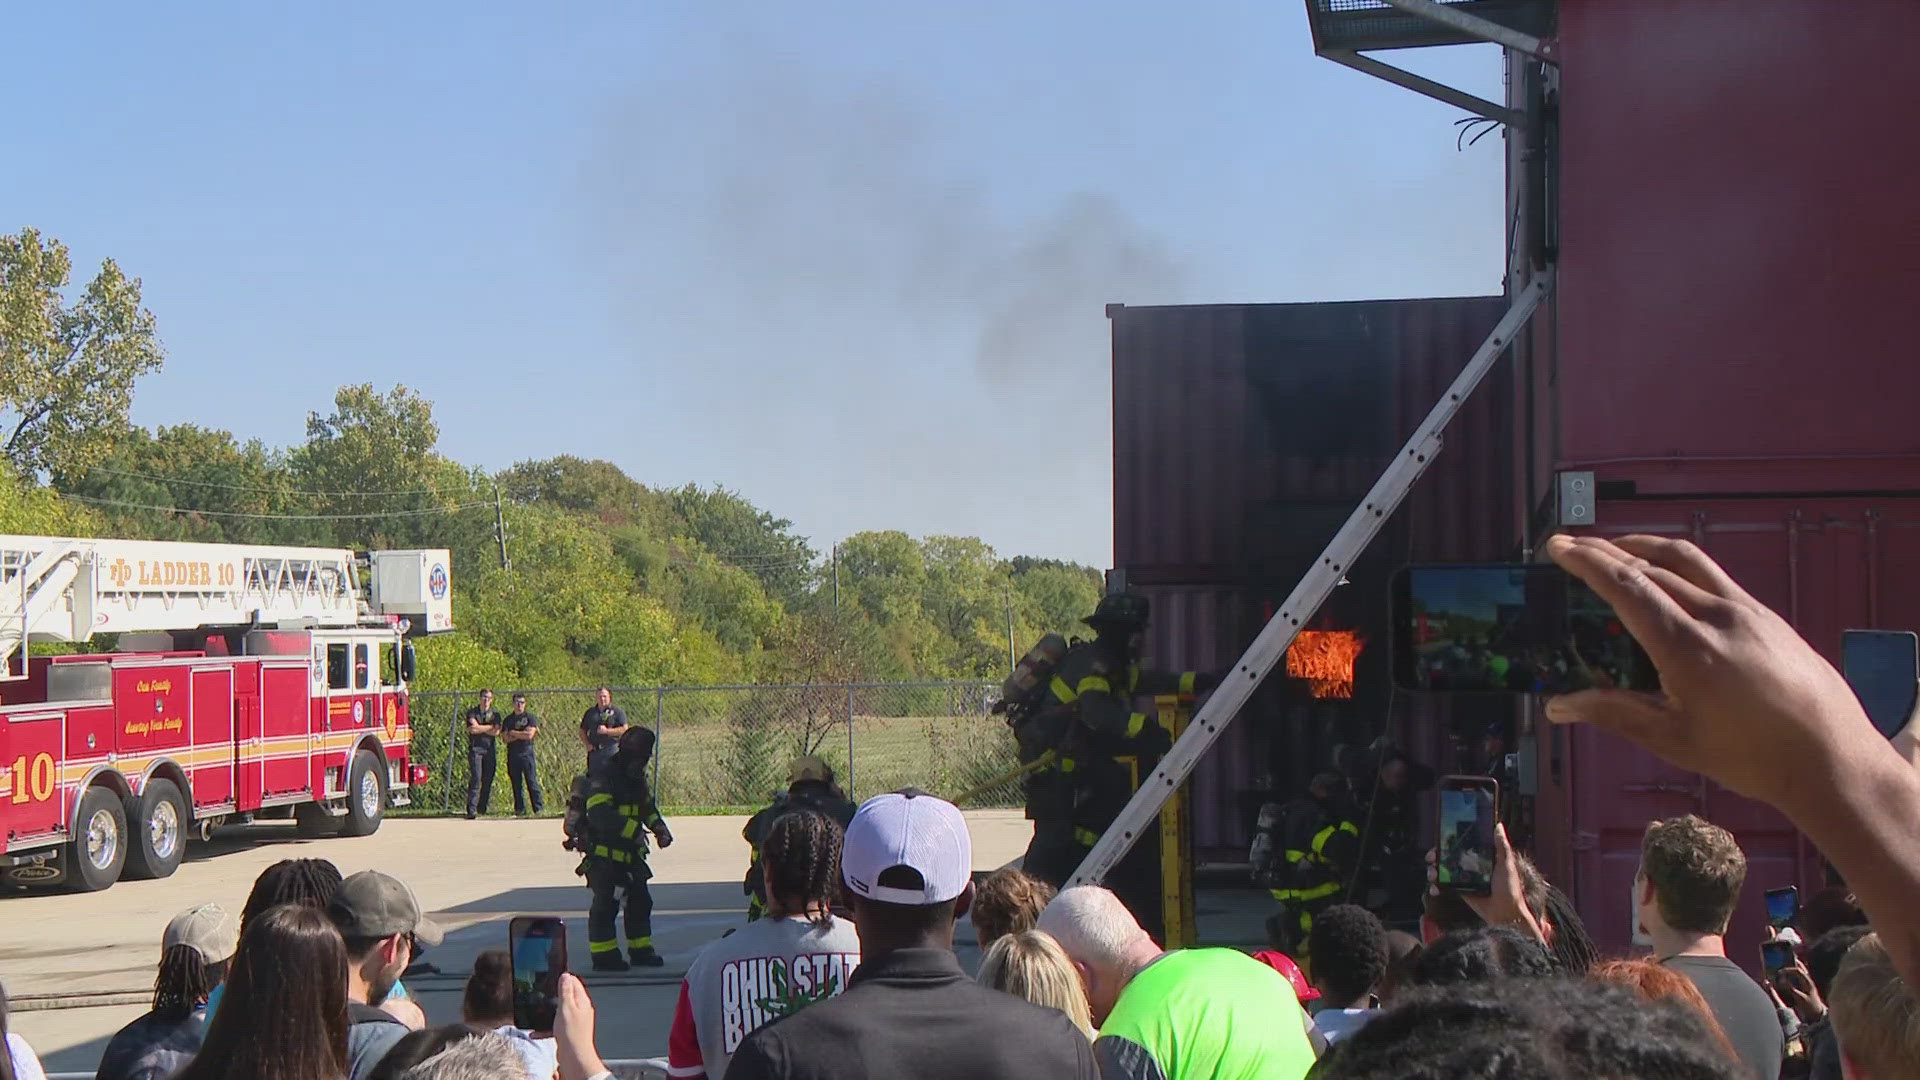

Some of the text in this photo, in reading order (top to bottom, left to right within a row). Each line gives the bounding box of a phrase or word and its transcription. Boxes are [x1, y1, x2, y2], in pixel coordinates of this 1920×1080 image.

[138, 560, 212, 586] LADDER
[218, 562, 236, 586] 10
[150, 679, 172, 696] Family
[12, 752, 56, 805] 10
[721, 952, 863, 1012] OHIO STAT
